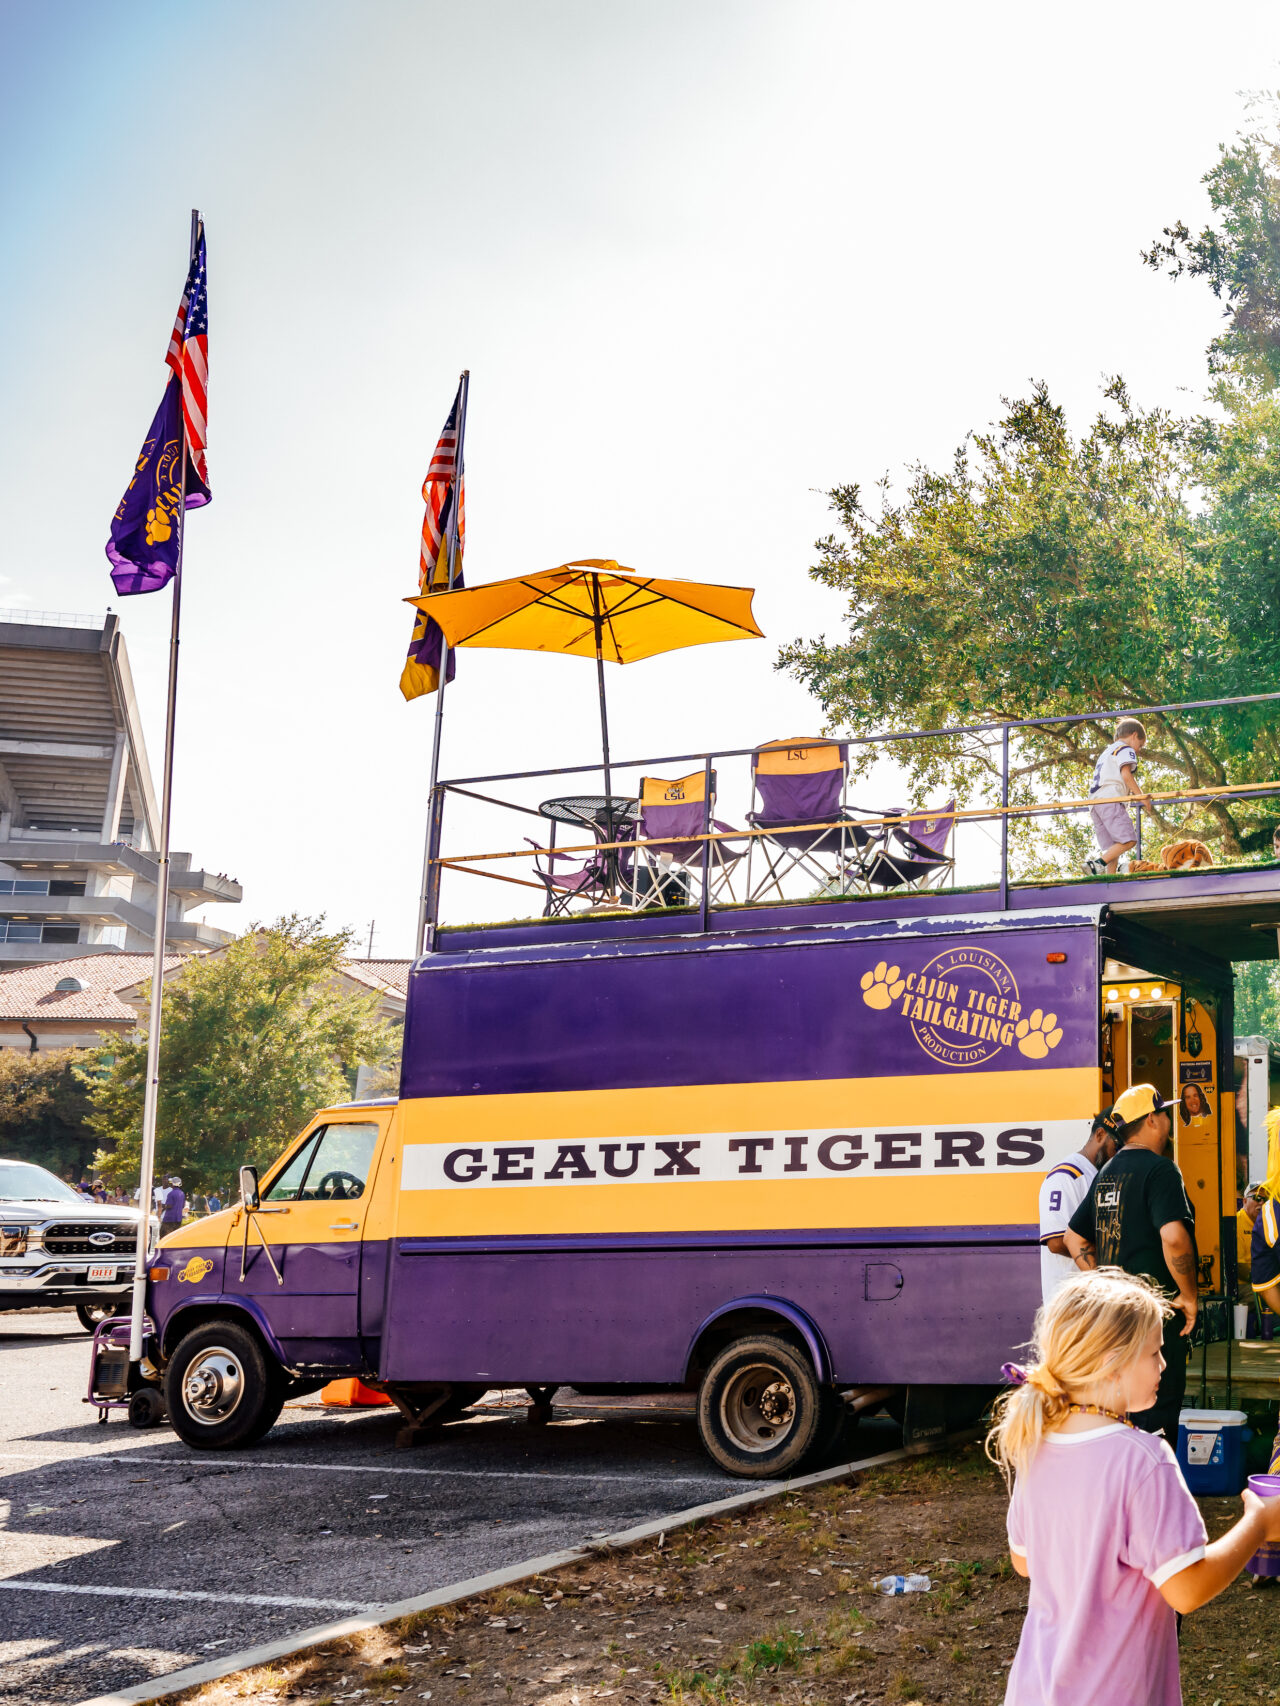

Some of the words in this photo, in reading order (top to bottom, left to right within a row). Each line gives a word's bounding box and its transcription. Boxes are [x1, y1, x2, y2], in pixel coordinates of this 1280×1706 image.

[787, 749, 808, 761] LSU
[1129, 751, 1136, 760] 9
[664, 792, 685, 800] LSU
[935, 963, 945, 973] A
[950, 952, 1012, 995] LOUISIANA
[906, 972, 959, 1003] CAJUN
[967, 989, 1022, 1021] TIGER
[901, 992, 1016, 1047] TAILGATING
[918, 1026, 987, 1061] PRODUCTION
[443, 1140, 701, 1183] GEAUX
[728, 1128, 1046, 1173] TIGERS
[1049, 1190, 1062, 1211] 9
[1097, 1191, 1120, 1207] LSU
